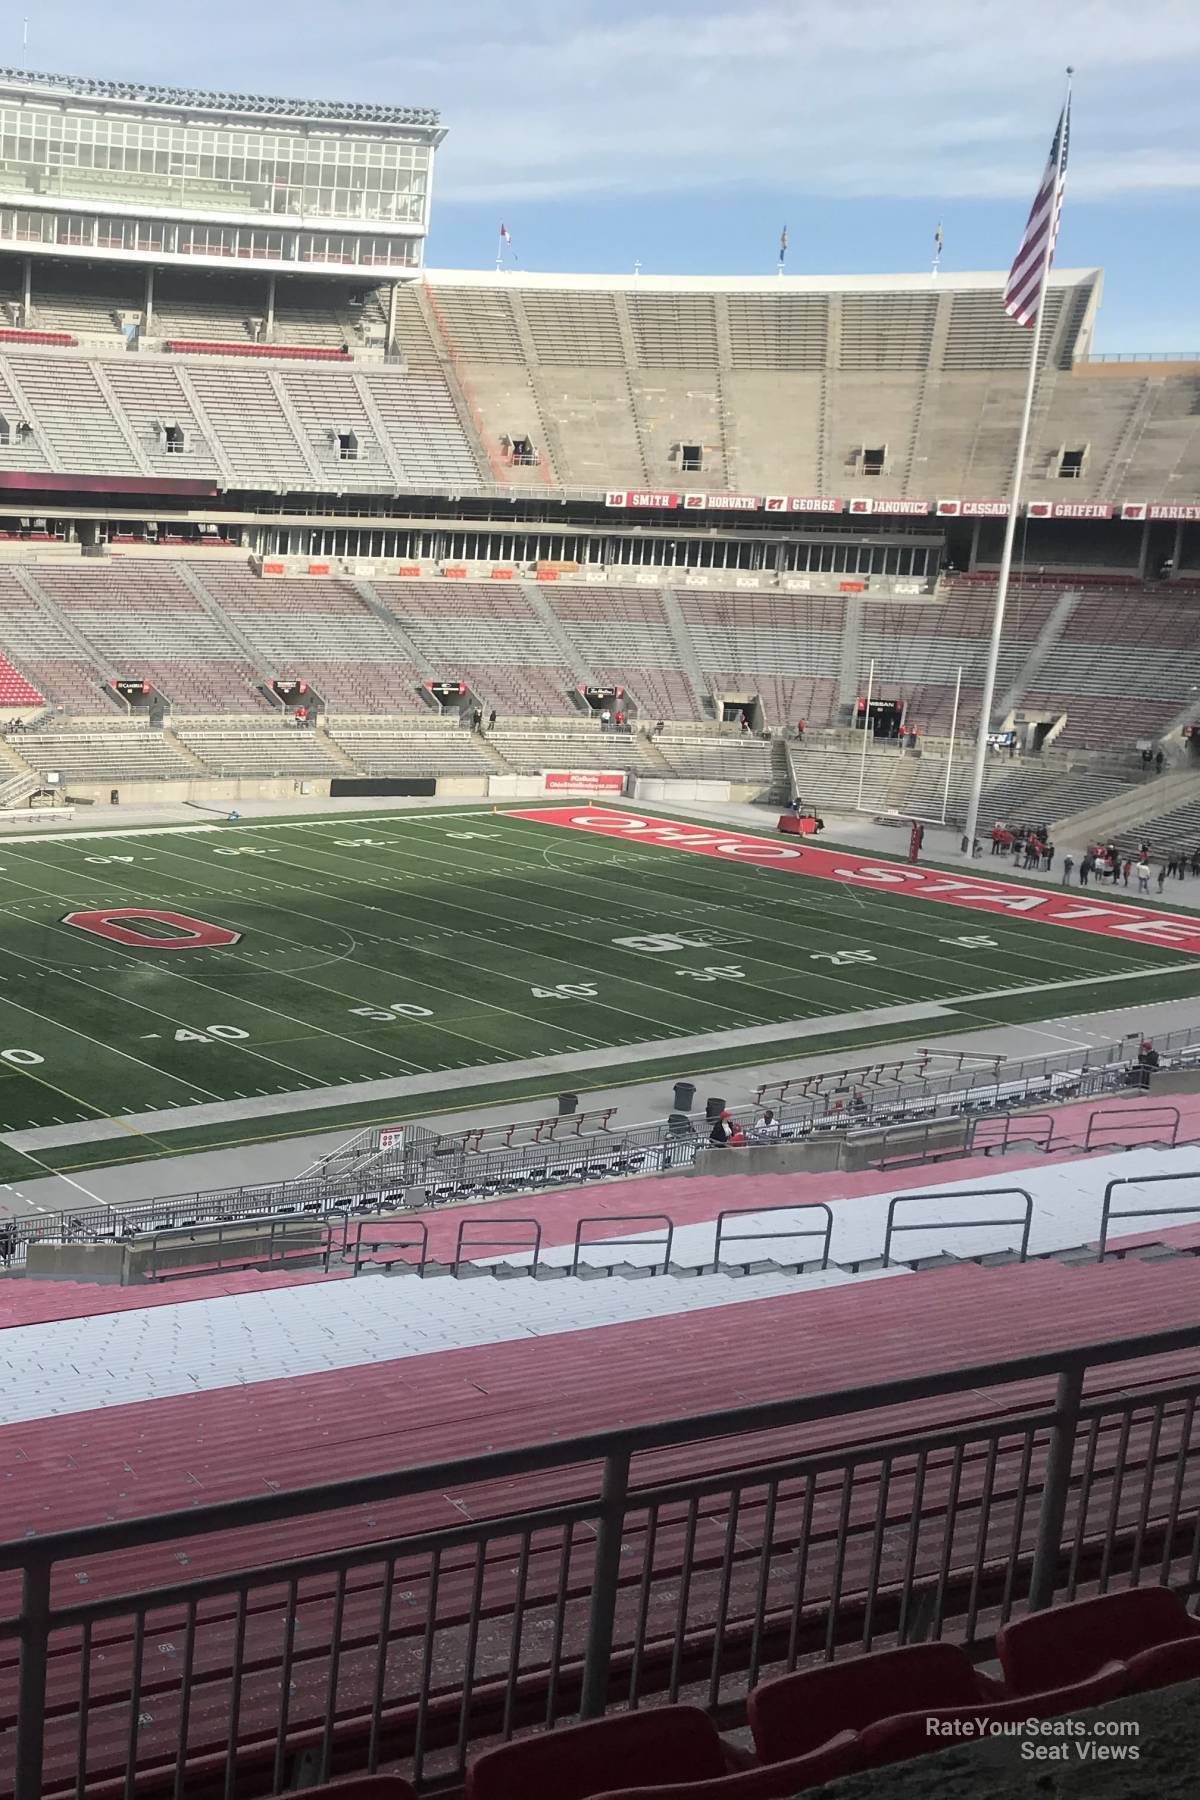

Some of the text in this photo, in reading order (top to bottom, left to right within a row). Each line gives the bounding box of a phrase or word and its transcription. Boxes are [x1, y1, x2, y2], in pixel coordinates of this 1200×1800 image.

[608, 494, 669, 506] 10 SMITH
[686, 496, 755, 509] 22 HORVATH
[767, 498, 835, 511] 27 GEORGE
[872, 501, 928, 513] JANOWICZ
[1055, 504, 1107, 517] GRIFFIN
[1150, 506, 1200, 519] HARLEY
[570, 815, 1200, 942] OHIO STATE
[59, 907, 245, 950] O
[938, 935, 999, 949] 10
[810, 950, 878, 966] 20
[675, 966, 746, 983] 30
[530, 983, 599, 1001] 40
[347, 1003, 435, 1023] 50
[173, 1024, 250, 1044] 40
